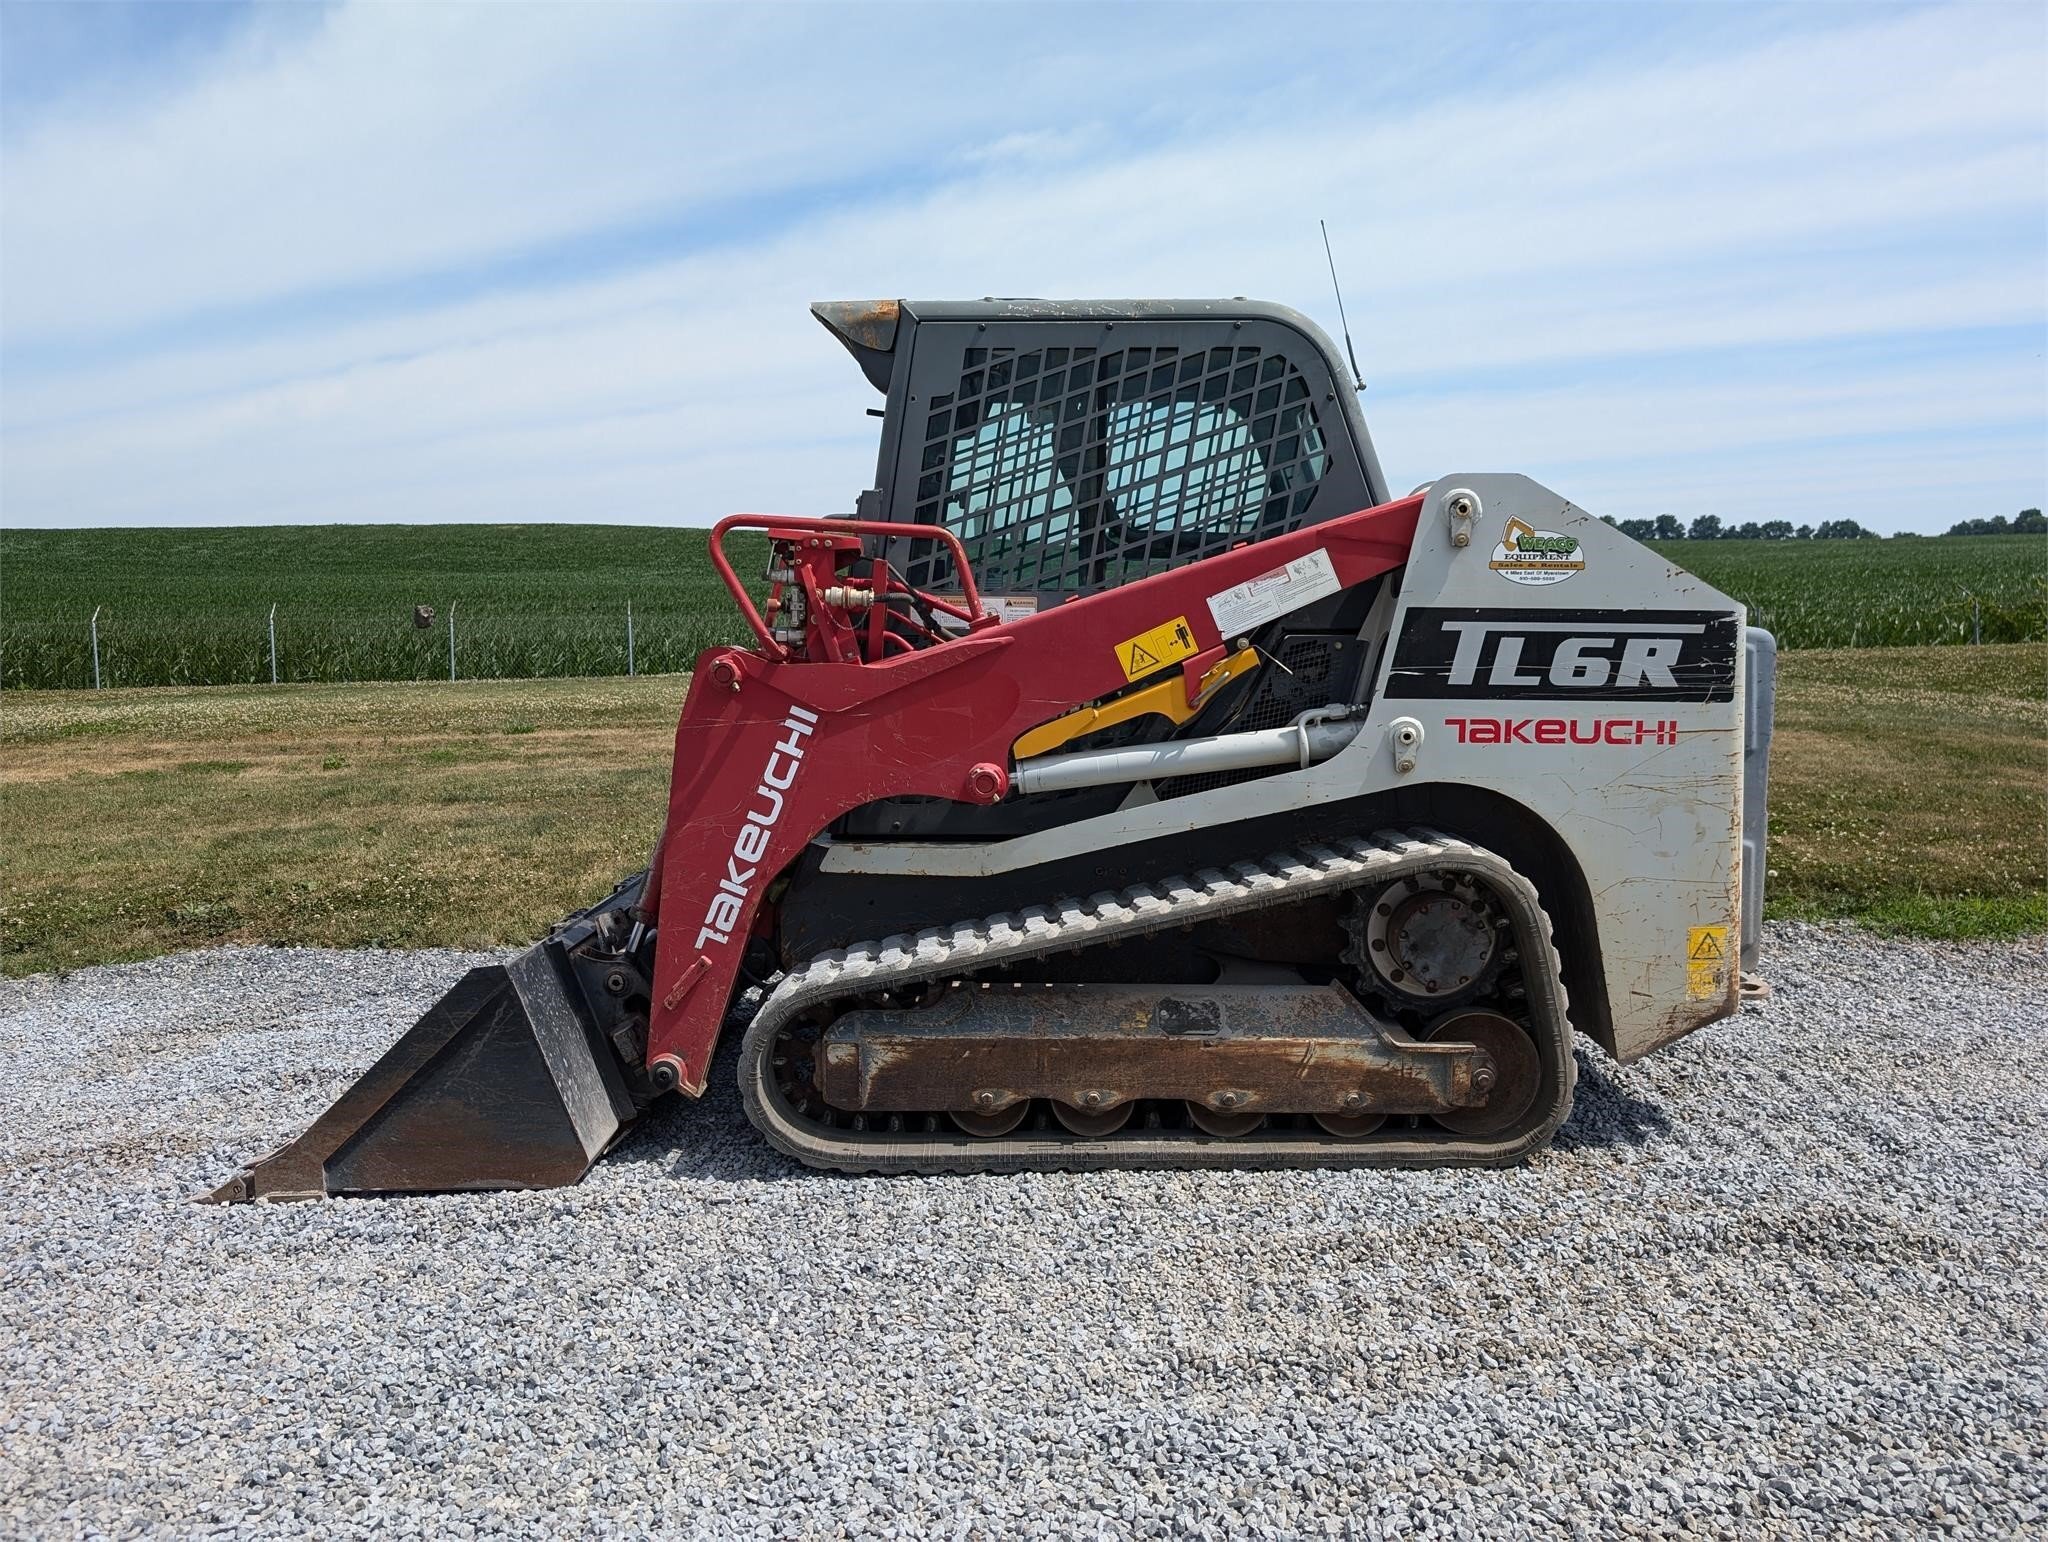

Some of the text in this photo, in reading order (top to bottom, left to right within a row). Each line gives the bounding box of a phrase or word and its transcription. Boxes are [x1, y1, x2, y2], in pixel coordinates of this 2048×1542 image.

[1517, 533, 1579, 553] WEACO
[1504, 553, 1570, 562] EQUIPMENT
[1441, 621, 1706, 687] TL6R
